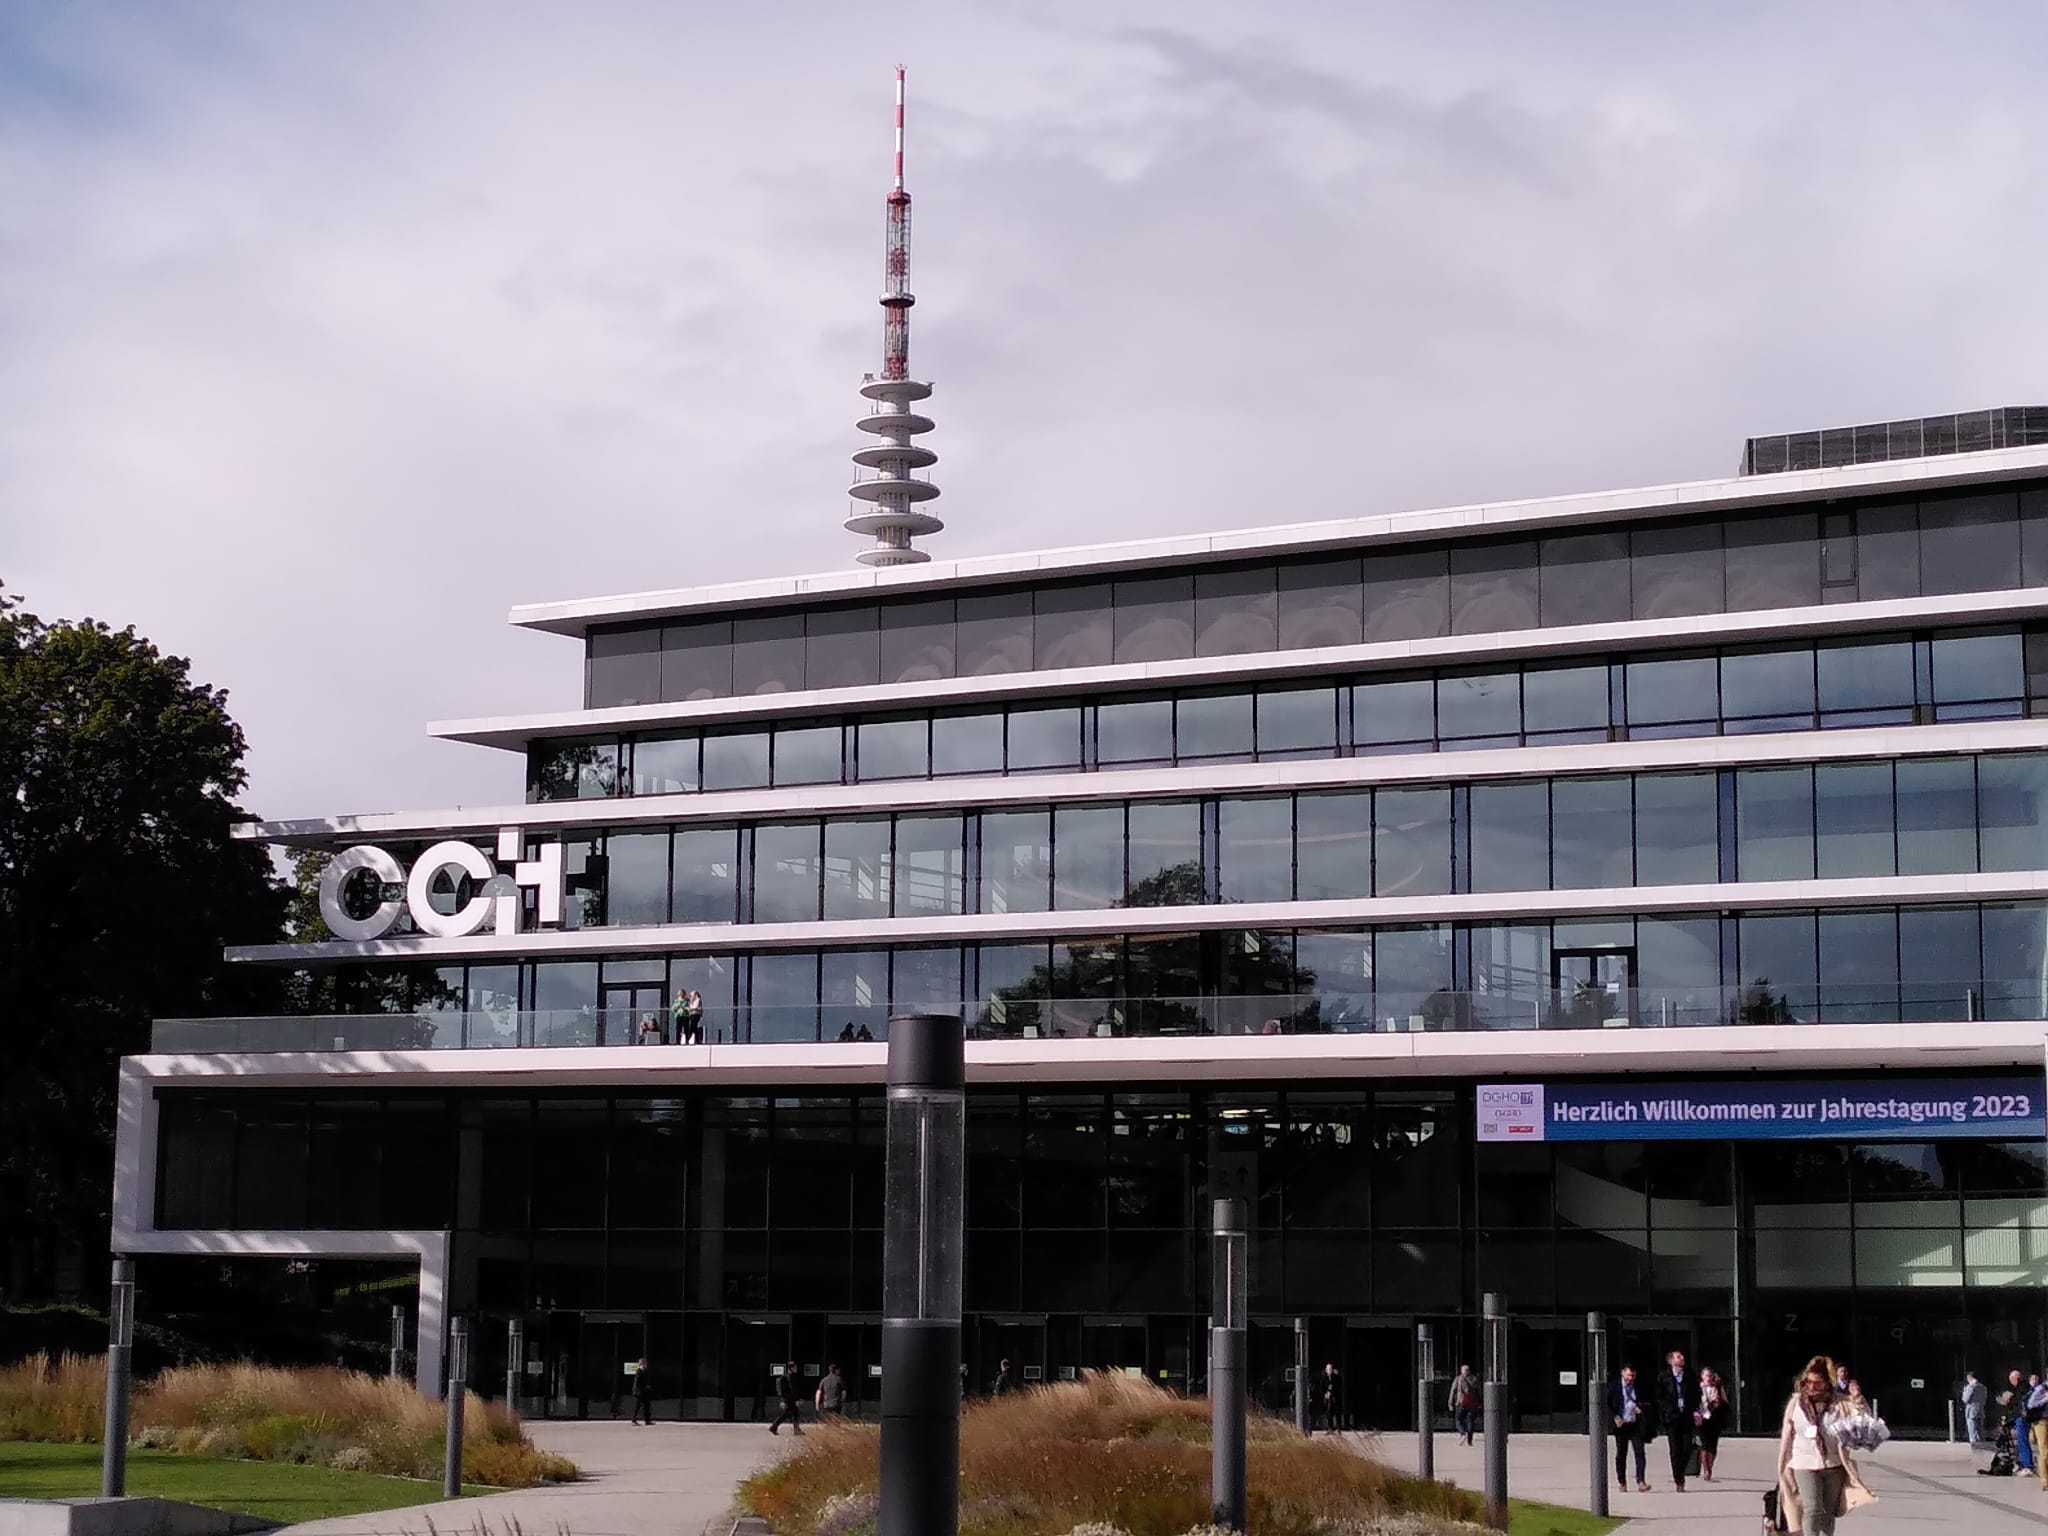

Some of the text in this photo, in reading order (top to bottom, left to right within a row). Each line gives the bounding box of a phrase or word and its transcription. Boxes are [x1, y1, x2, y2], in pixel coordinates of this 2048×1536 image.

[318, 827, 562, 941] CCH
[1482, 1091, 1519, 1103] DGHO
[1553, 1095, 2031, 1122] Herzlich Willkommen zur Jahrestagung 2023
